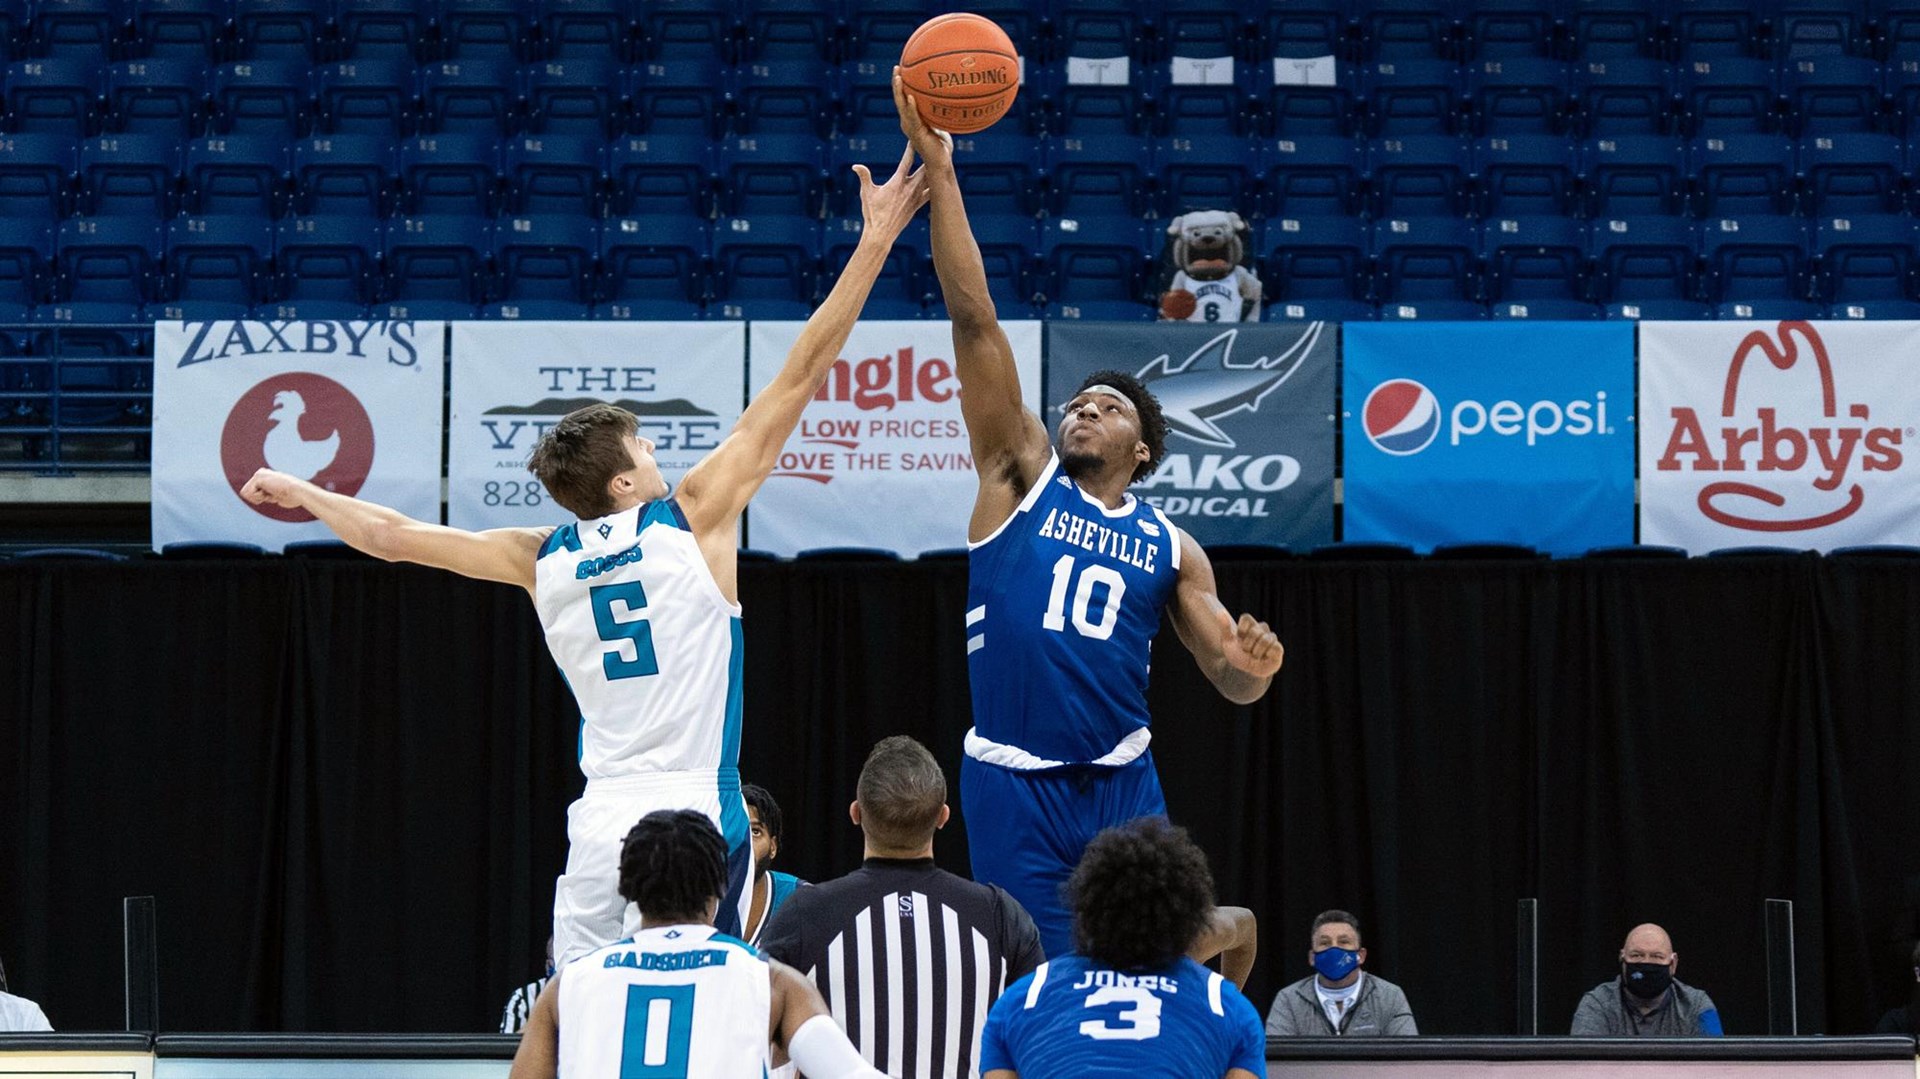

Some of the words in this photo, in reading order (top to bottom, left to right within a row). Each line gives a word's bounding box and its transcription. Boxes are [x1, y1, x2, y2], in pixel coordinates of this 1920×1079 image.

[928, 66, 1007, 89] SPALDING
[1204, 301, 1220, 322] 6
[177, 320, 417, 368] ZAXBY'S
[539, 366, 656, 392] THE
[813, 345, 962, 412] ngle
[801, 419, 861, 438] LOW
[869, 419, 967, 438] PRICES.
[1450, 390, 1607, 446] pepsi
[773, 452, 835, 471] OVE
[844, 453, 892, 471] THE
[901, 452, 972, 471] SAVIN
[1657, 403, 1903, 491] Arby's
[1130, 453, 1300, 493] AKO
[1140, 496, 1270, 517] EDICAL
[1039, 508, 1158, 574] ASHEVILLE
[1042, 554, 1126, 640] 10
[589, 580, 659, 681] 5
[1073, 970, 1178, 994] JONES
[621, 983, 696, 1079] 0
[1079, 987, 1162, 1041] 3
